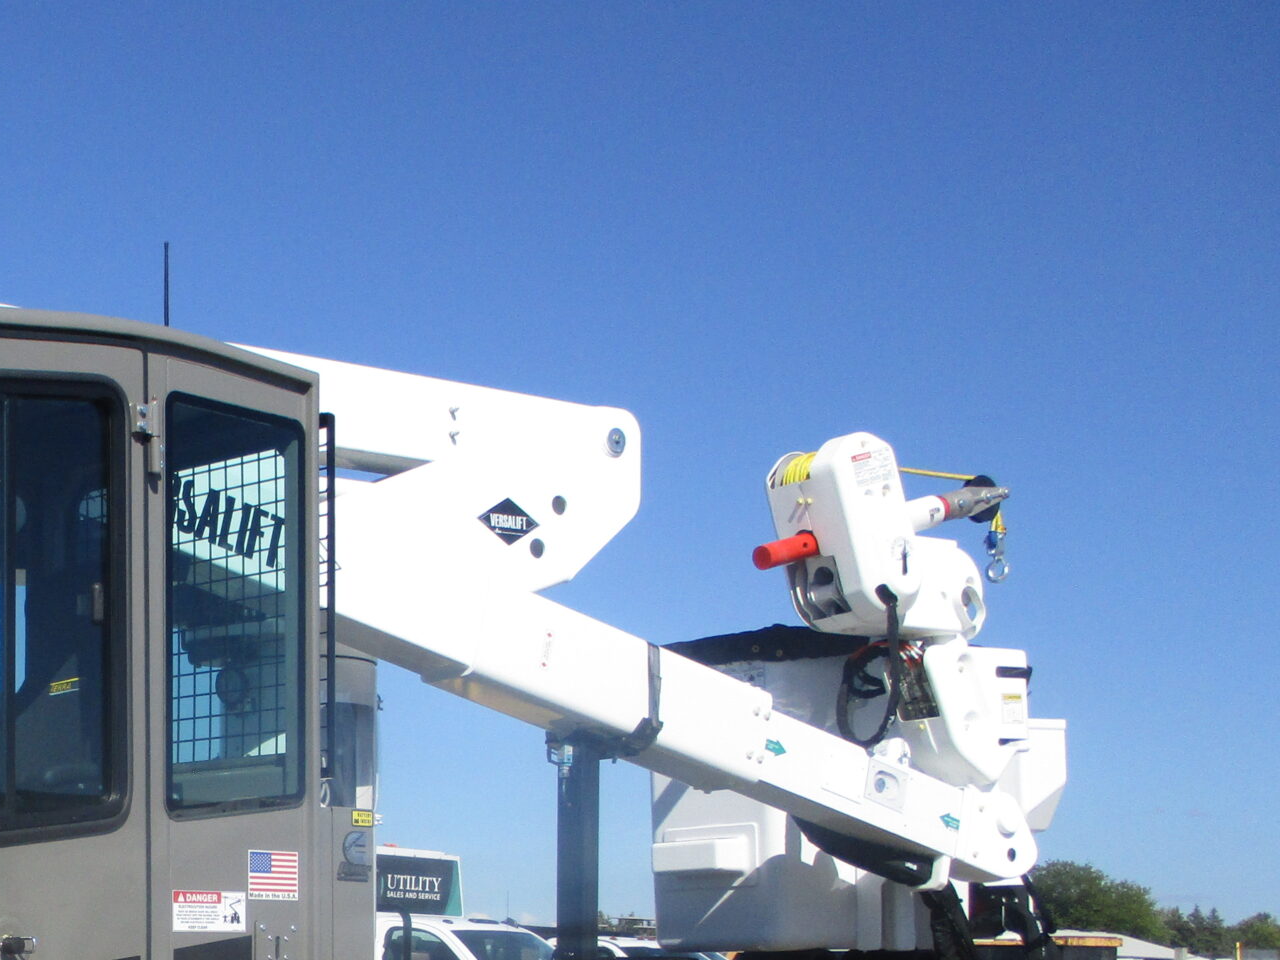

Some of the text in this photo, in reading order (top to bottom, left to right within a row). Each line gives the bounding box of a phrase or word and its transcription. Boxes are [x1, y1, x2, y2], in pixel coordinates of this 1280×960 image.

[172, 473, 286, 569] SALIFT
[490, 512, 528, 530] VERSALIFT
[387, 874, 442, 892] UTILITY
[186, 893, 218, 903] DANGER
[386, 890, 404, 898] SALES
[418, 893, 441, 901] SERVICE
